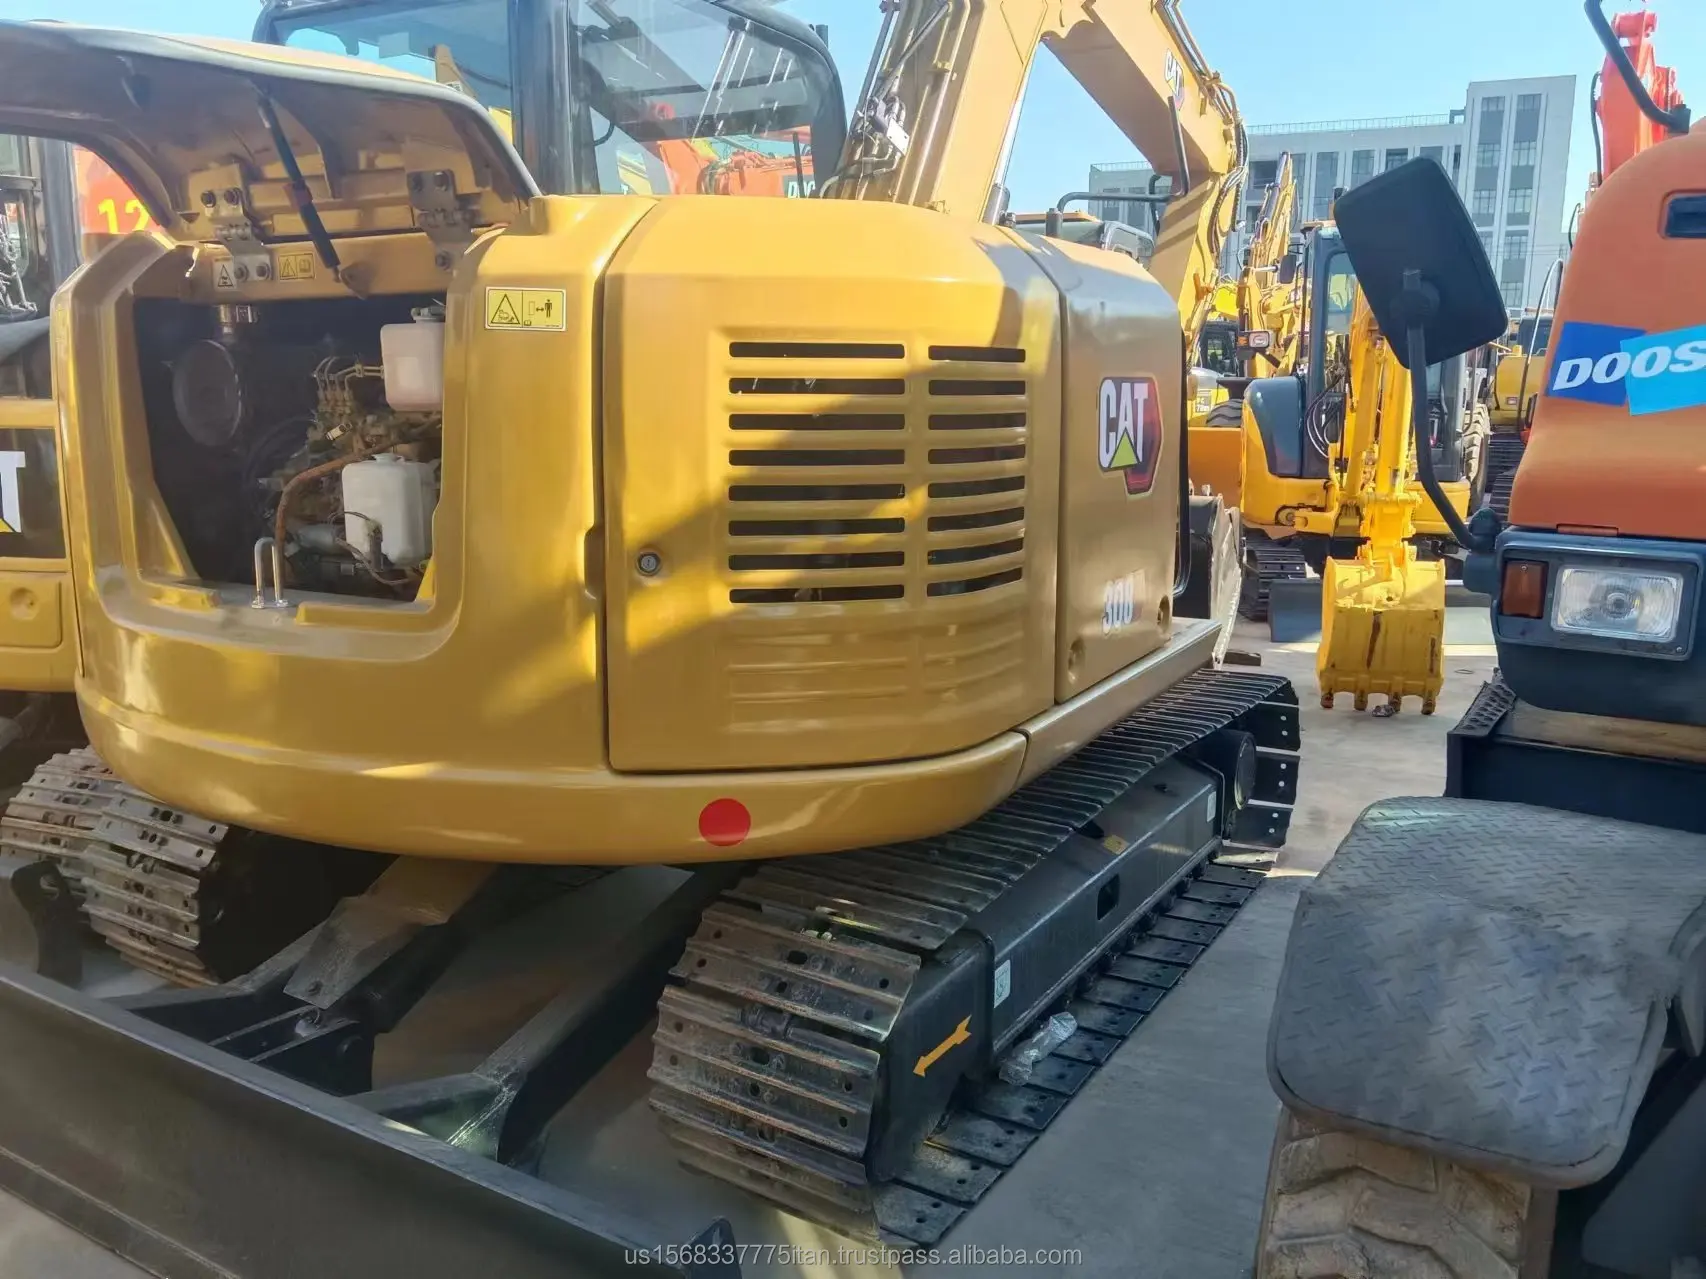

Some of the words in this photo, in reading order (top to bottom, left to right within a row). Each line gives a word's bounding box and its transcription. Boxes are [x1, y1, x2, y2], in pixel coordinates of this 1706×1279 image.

[1164, 48, 1183, 97] CAT
[1552, 340, 1706, 391] DOOS
[1099, 379, 1149, 468] CAT
